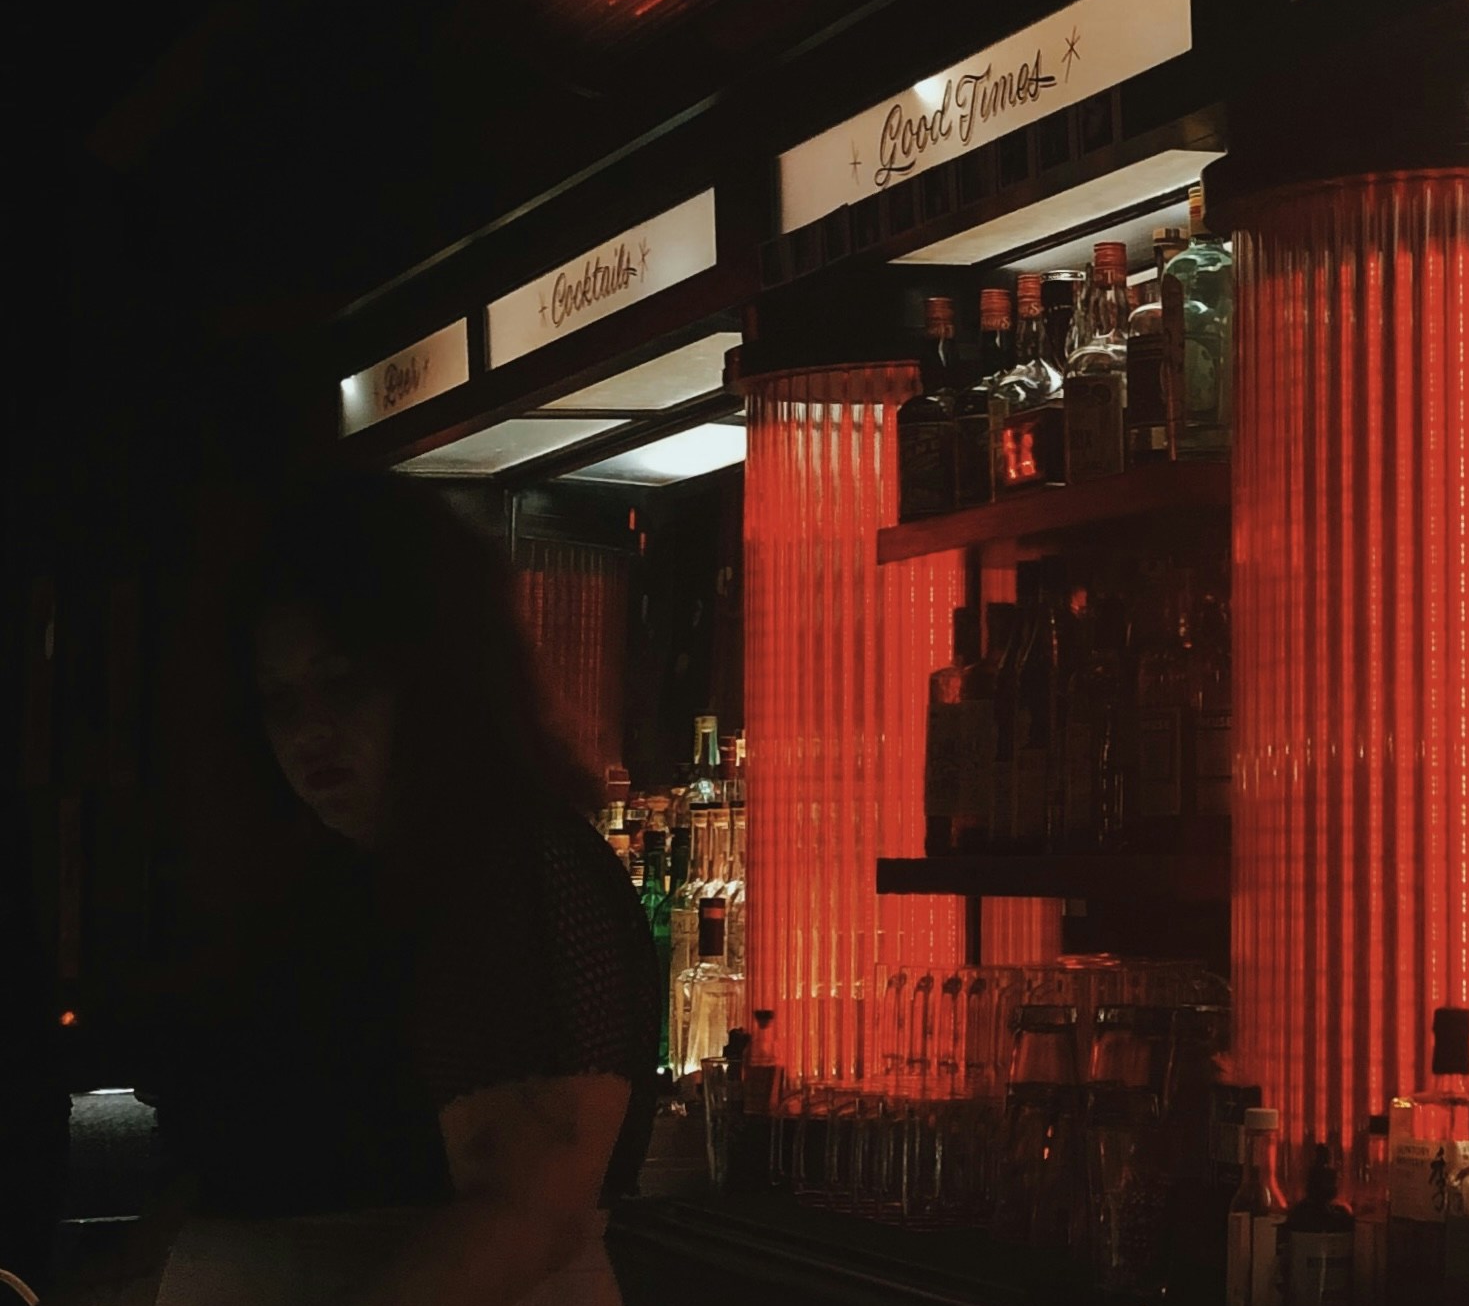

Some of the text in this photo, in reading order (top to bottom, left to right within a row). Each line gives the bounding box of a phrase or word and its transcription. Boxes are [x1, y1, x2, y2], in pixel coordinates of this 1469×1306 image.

[874, 48, 1057, 188] Good Times
[551, 243, 638, 329] Cocktails
